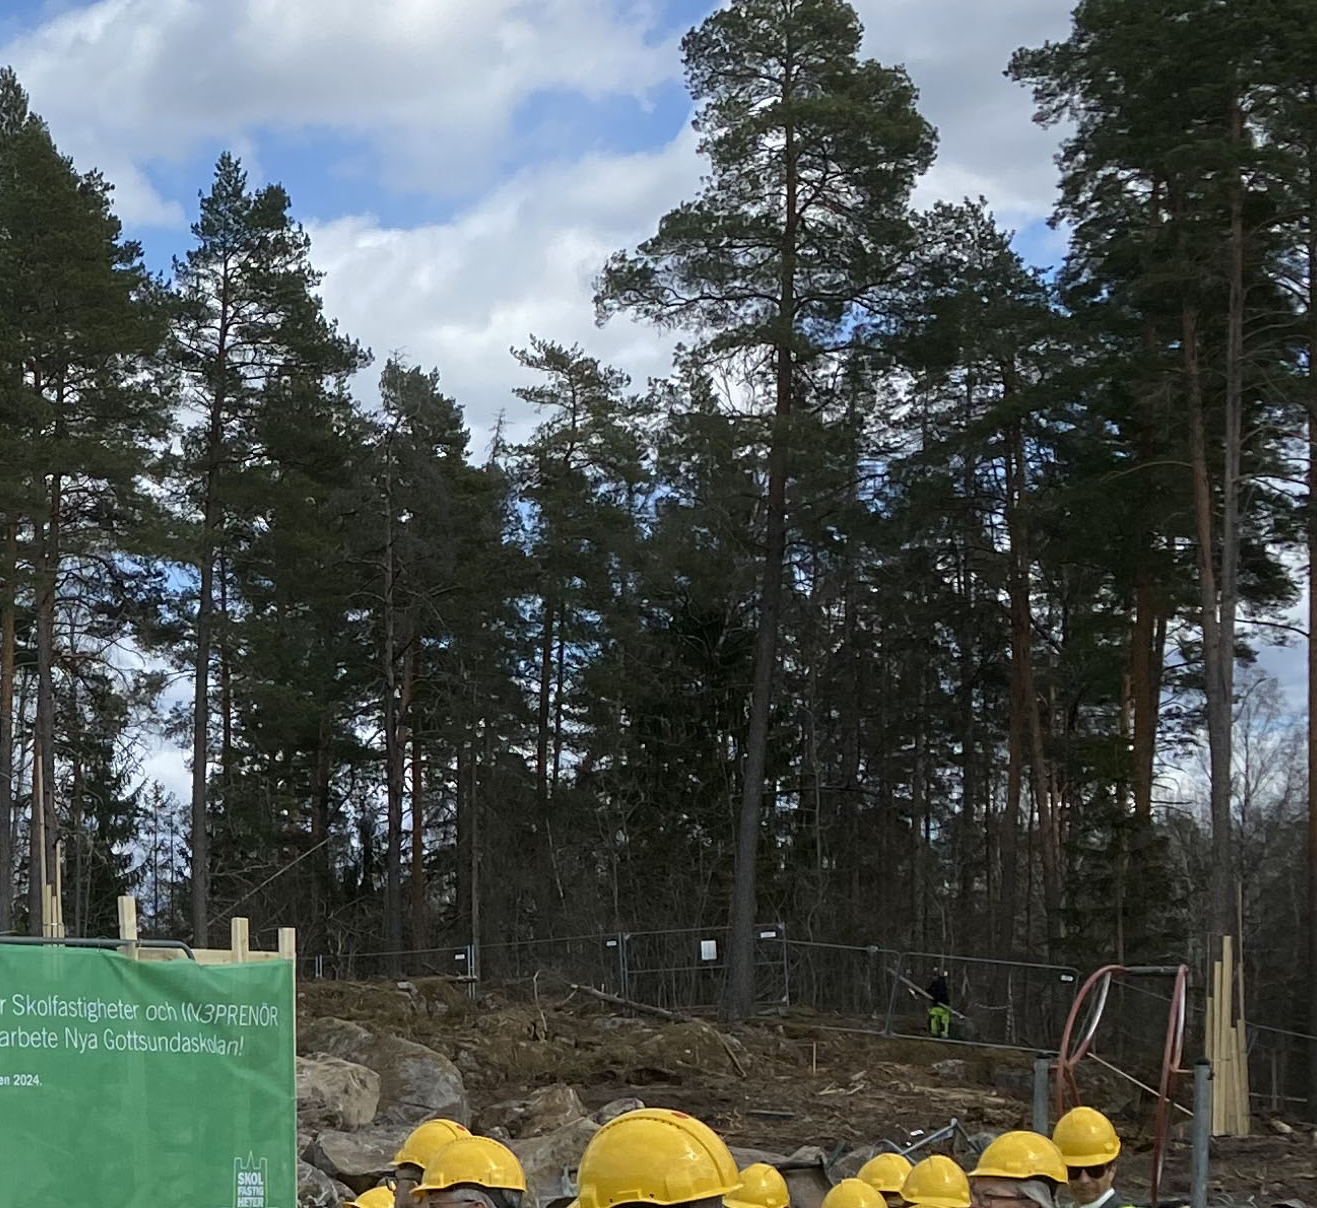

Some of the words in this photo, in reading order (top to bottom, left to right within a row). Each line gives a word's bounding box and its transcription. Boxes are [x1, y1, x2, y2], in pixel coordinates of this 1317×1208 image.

[12, 993, 139, 1023] Skolfastigheter
[146, 1001, 177, 1022] och
[181, 1001, 278, 1027] IN3PRENÖR
[64, 1026, 98, 1054] Nya
[103, 1028, 244, 1057] Gottsundaskolan!
[13, 1074, 43, 1086] 2024.
[237, 1171, 264, 1186] SKOL
